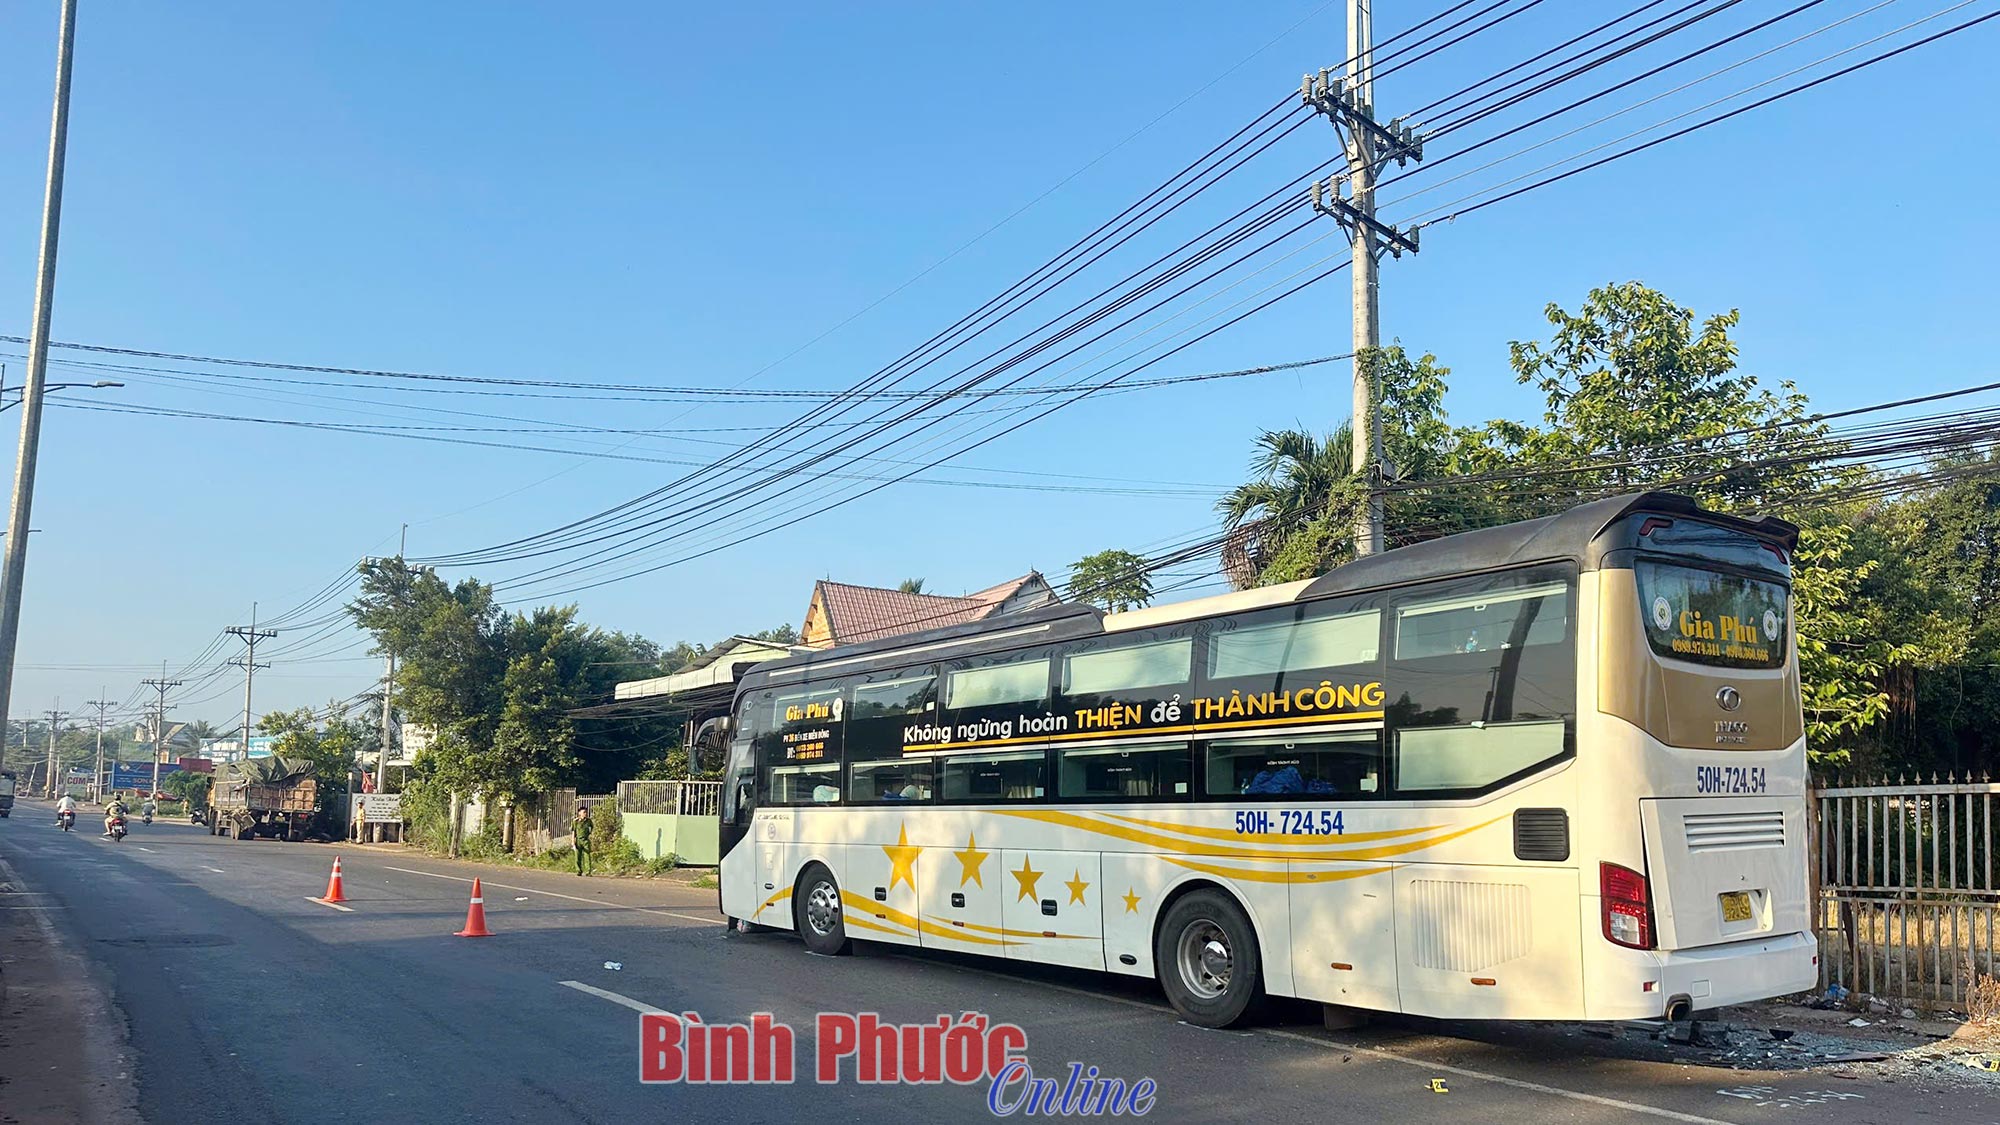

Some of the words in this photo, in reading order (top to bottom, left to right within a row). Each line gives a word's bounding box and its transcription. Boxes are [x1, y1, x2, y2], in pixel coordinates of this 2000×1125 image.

[1680, 610, 1716, 639] Gia
[1719, 614, 1758, 645] Phú
[785, 704, 804, 722] Gia
[806, 701, 829, 719] Phú
[904, 722, 951, 744] Không
[957, 716, 1012, 740] ngừng
[1019, 711, 1068, 732] hoàn
[1075, 702, 1142, 731] THIỆN
[1150, 694, 1182, 723] để
[1192, 689, 1291, 720] THÀNH
[1294, 680, 1385, 711] CÔNG
[1697, 765, 1767, 794] 50H-724.54
[1280, 811, 1344, 835] 724.54
